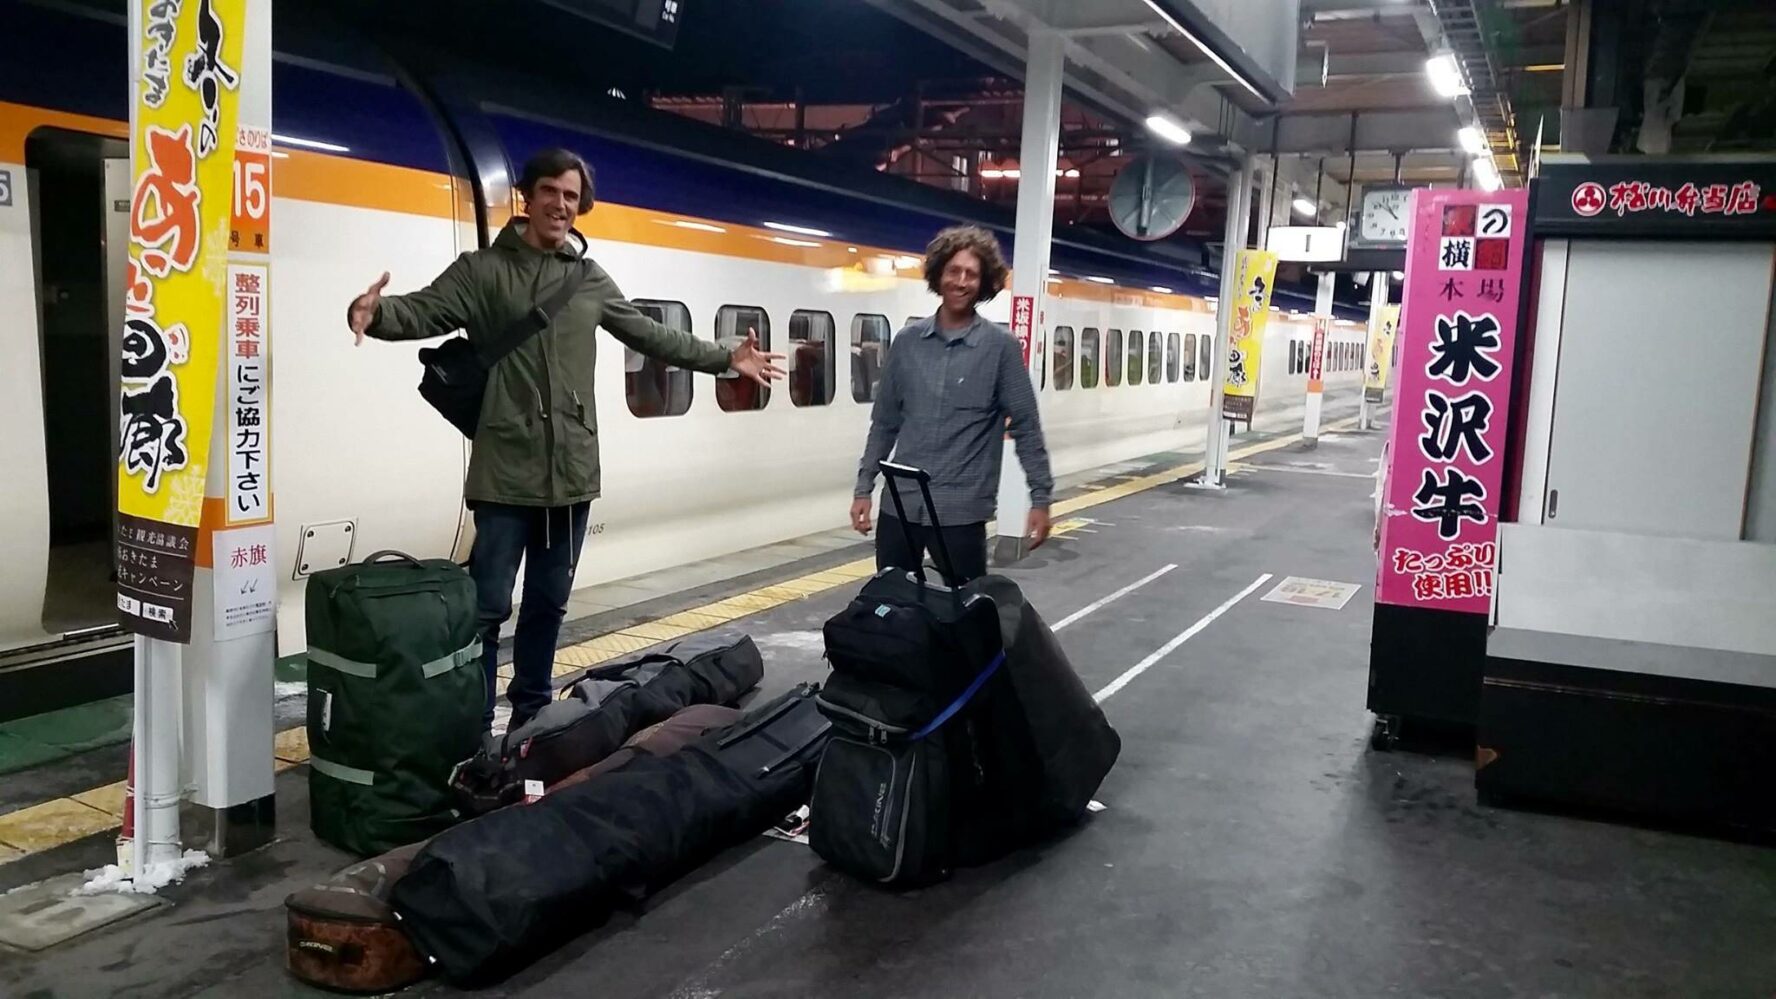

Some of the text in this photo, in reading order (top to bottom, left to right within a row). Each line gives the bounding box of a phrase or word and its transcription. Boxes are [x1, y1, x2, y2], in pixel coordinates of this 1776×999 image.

[236, 127, 268, 149] さのりば
[233, 160, 266, 219] 15
[1482, 208, 1508, 234] の
[1442, 239, 1471, 268] 横
[1014, 297, 1031, 353] 米坂線の
[1413, 312, 1503, 539] 米沢牛
[118, 525, 190, 551] たま観光協議会
[231, 544, 267, 568] 赤旗
[1393, 542, 1496, 573] たっぷり
